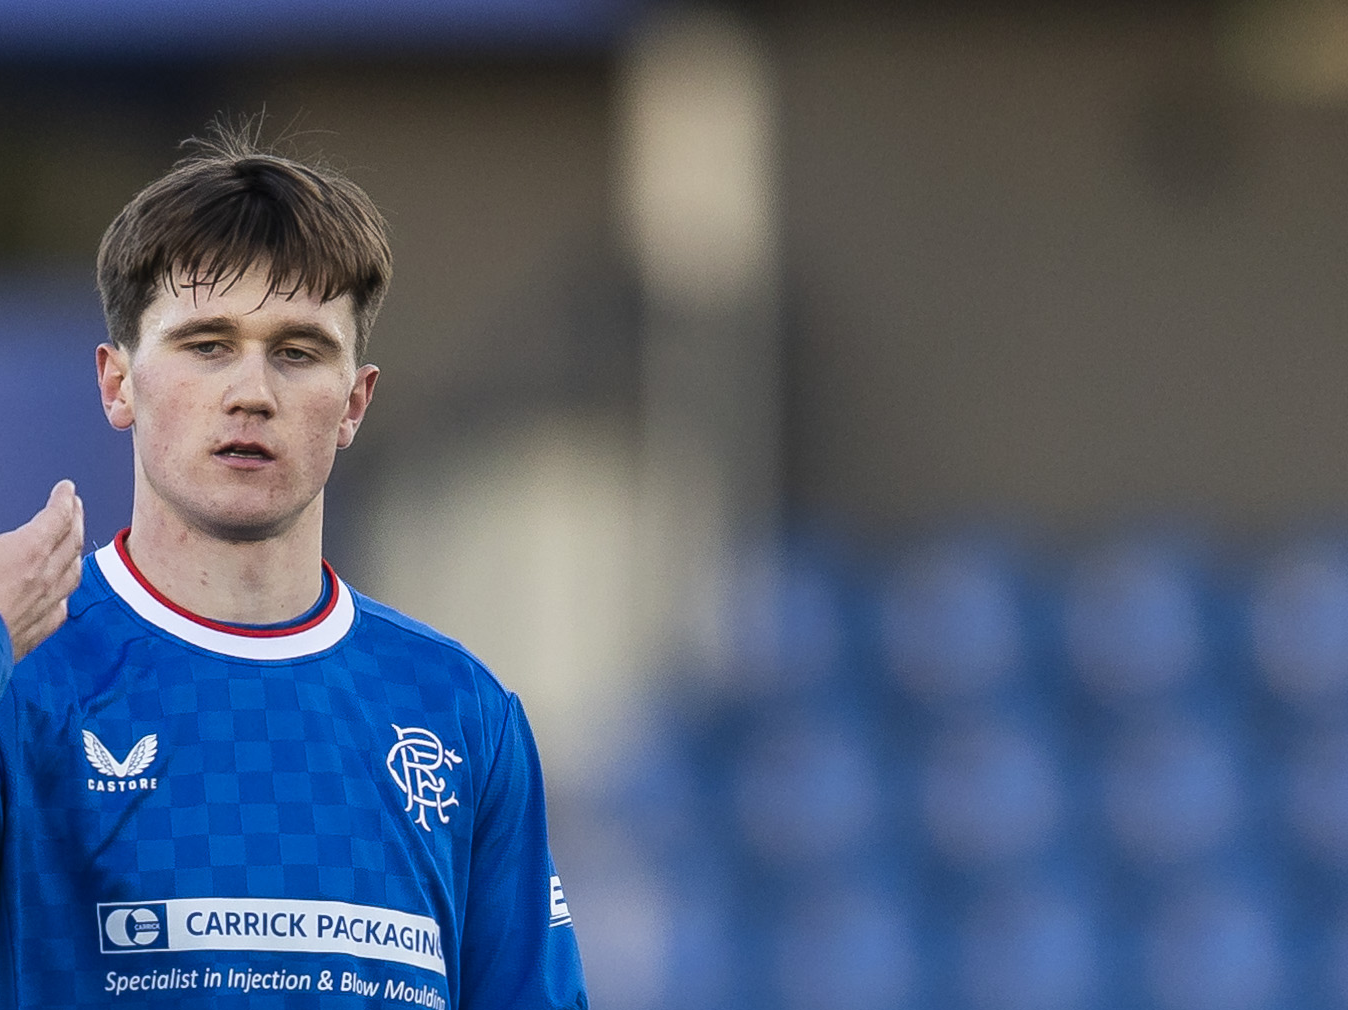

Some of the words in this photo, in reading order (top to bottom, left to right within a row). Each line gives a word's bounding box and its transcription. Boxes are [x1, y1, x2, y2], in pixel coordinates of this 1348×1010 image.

[87, 777, 158, 793] CASTORE
[186, 911, 308, 938] CARRICK
[104, 967, 199, 996] Specialist
[203, 967, 222, 988] in
[227, 967, 311, 994] Injection
[317, 970, 334, 991] &
[340, 971, 380, 998] Blow
